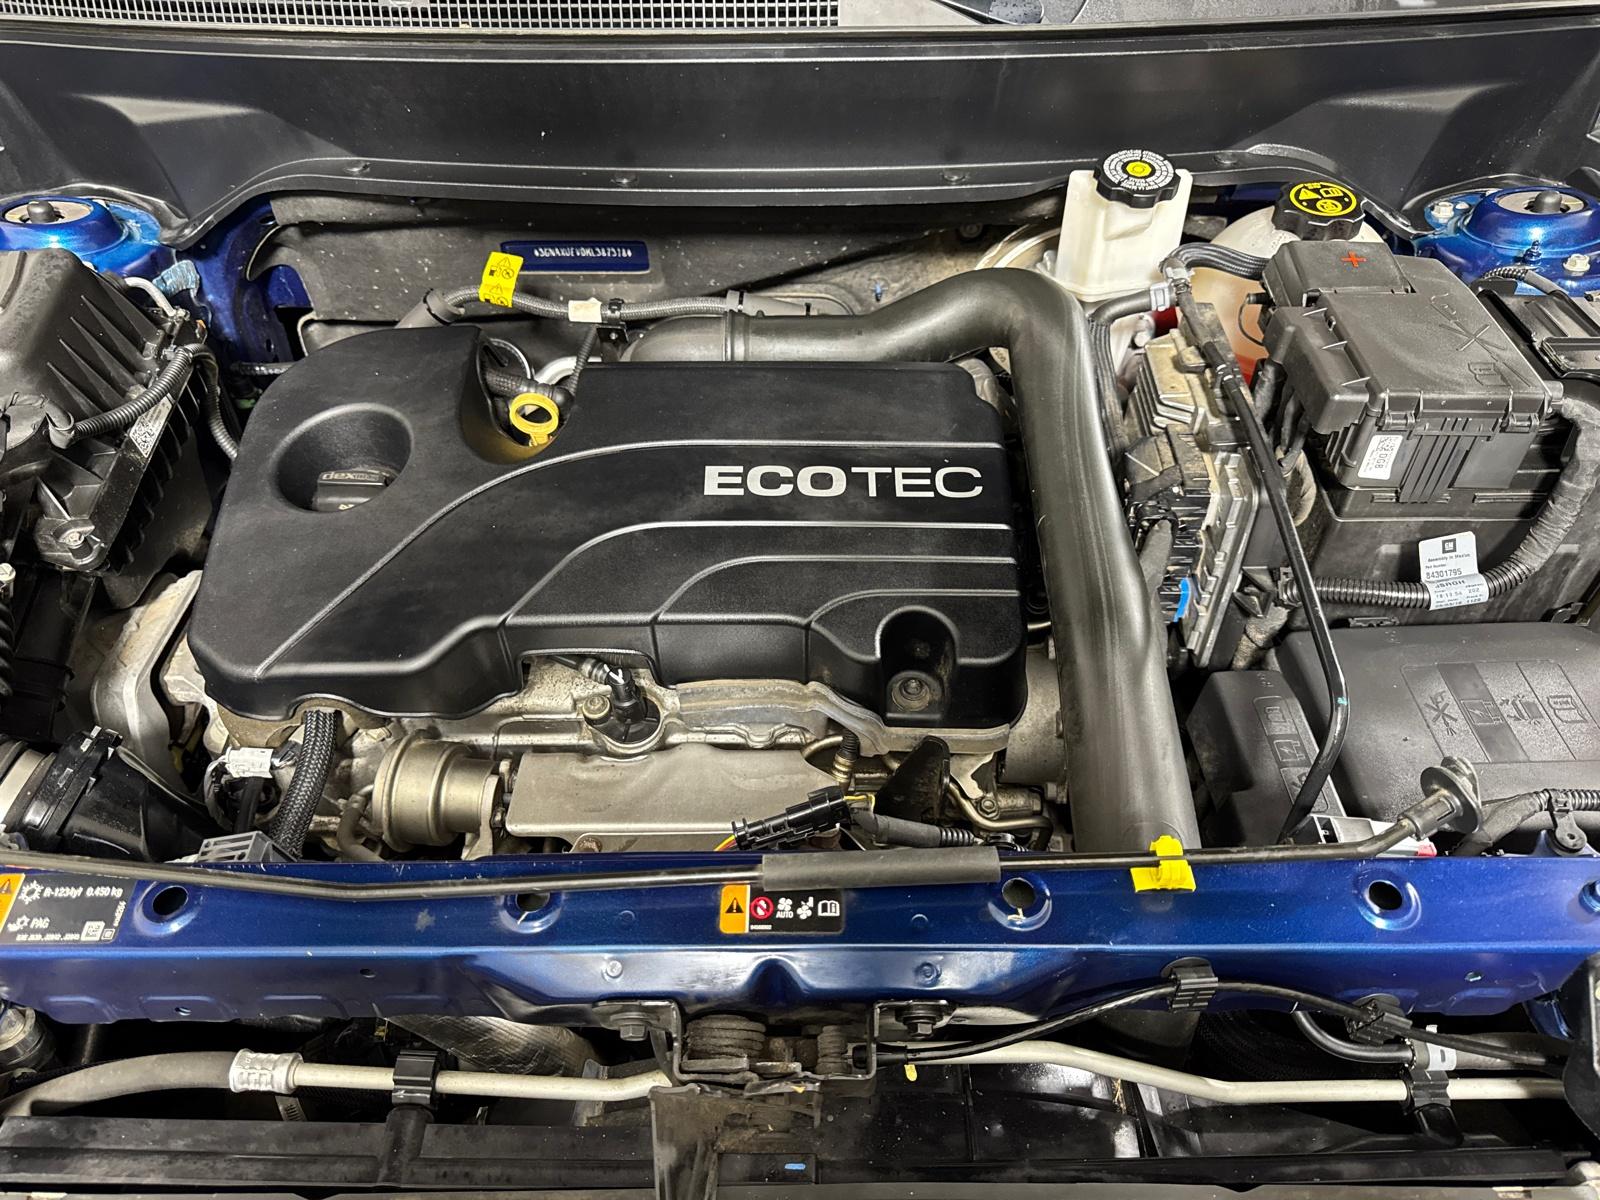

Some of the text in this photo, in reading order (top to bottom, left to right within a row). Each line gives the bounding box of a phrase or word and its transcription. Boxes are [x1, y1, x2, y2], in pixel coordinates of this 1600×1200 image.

[703, 465, 984, 498] ECOTEC
[1426, 568, 1462, 579] 84301795
[86, 886, 110, 897] 0.450
[111, 886, 123, 898] kg
[776, 911, 794, 919] AUTO
[30, 917, 50, 929] PAG
